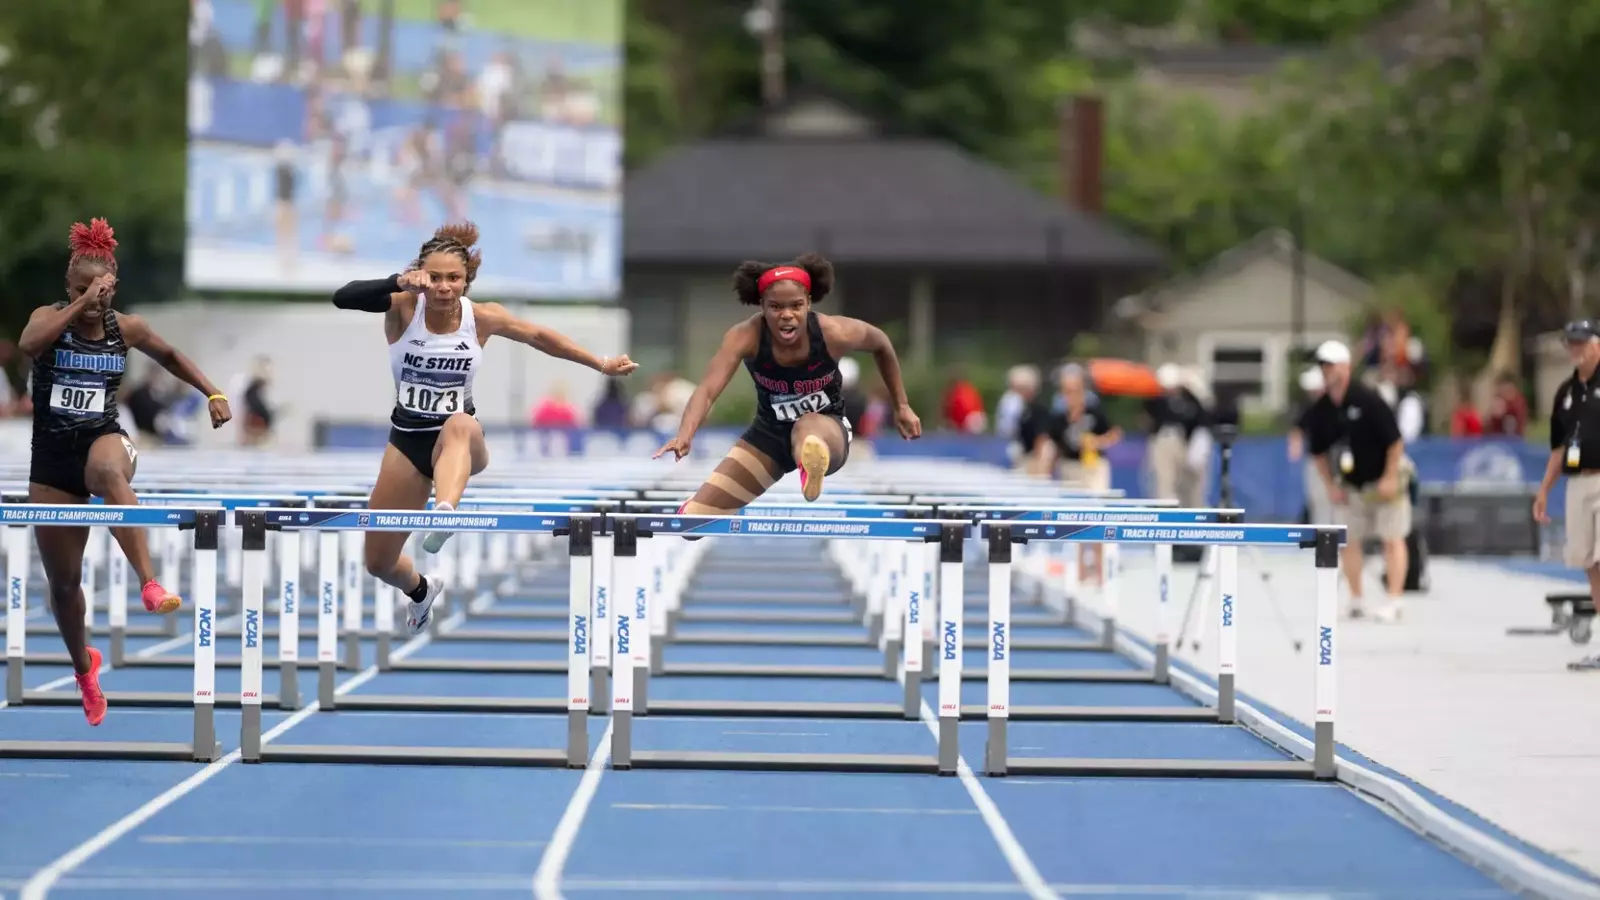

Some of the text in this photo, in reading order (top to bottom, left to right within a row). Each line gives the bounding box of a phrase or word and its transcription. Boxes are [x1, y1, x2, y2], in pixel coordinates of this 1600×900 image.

[408, 339, 426, 347] ACC
[55, 349, 126, 373] Memphis
[404, 352, 474, 371] NC STATE
[60, 388, 97, 410] 907
[405, 386, 459, 412] 1073
[778, 394, 827, 421] 1192
[2, 510, 124, 521] TRACK & FIELD CHAMPIONSHIPS
[376, 515, 402, 525] TRACK
[402, 516, 408, 525] &
[409, 516, 431, 526] FIELD
[432, 517, 498, 527] CHAMPIONSHIPS
[747, 522, 773, 532] TRACK
[773, 522, 780, 532] &
[781, 523, 802, 532] FIELD
[803, 523, 870, 534] CHAMPIONSHIPS
[1122, 528, 1148, 538] TRACK
[1148, 529, 1154, 538] &
[1155, 529, 1177, 539] FIELD
[1178, 529, 1244, 539] CHAMPIONSHIPS
[12, 577, 21, 609] NCAA
[285, 581, 294, 614] NCAA
[323, 581, 333, 614] NCAA
[596, 586, 606, 618] NCAA
[636, 587, 646, 619] NCAA
[909, 591, 918, 624] NCAA
[1222, 594, 1232, 627] NCAA
[198, 607, 212, 647] NCAA
[245, 609, 258, 648] NCAA
[574, 615, 587, 654] NCAA
[617, 615, 630, 654] NCAA
[944, 621, 956, 660] NCAA
[992, 621, 1005, 661] NCAA
[1319, 626, 1332, 666] NCAA
